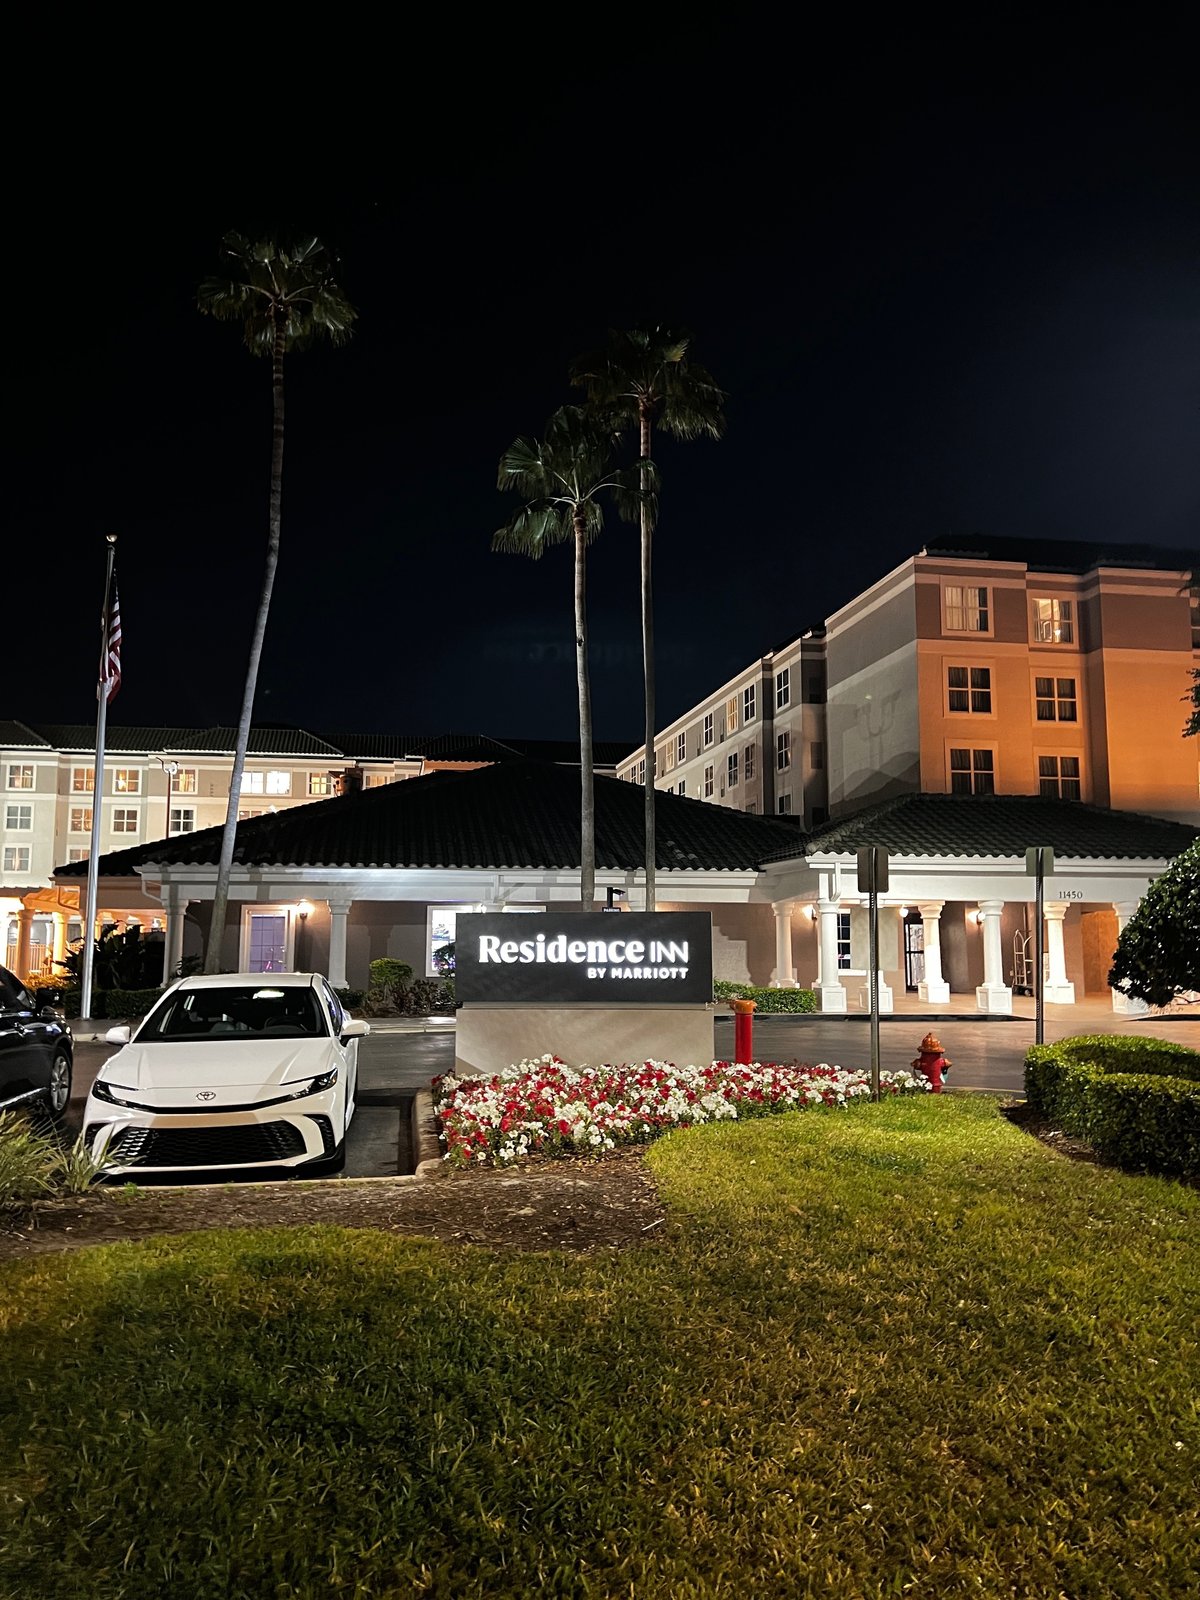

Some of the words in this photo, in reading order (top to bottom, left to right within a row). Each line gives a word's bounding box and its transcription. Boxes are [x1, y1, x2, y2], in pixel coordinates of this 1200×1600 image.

[1059, 890, 1083, 899] 11450
[478, 933, 645, 964] Residence
[649, 941, 689, 964] INN
[587, 967, 606, 979] BY
[610, 967, 689, 979] MARRIOTT
